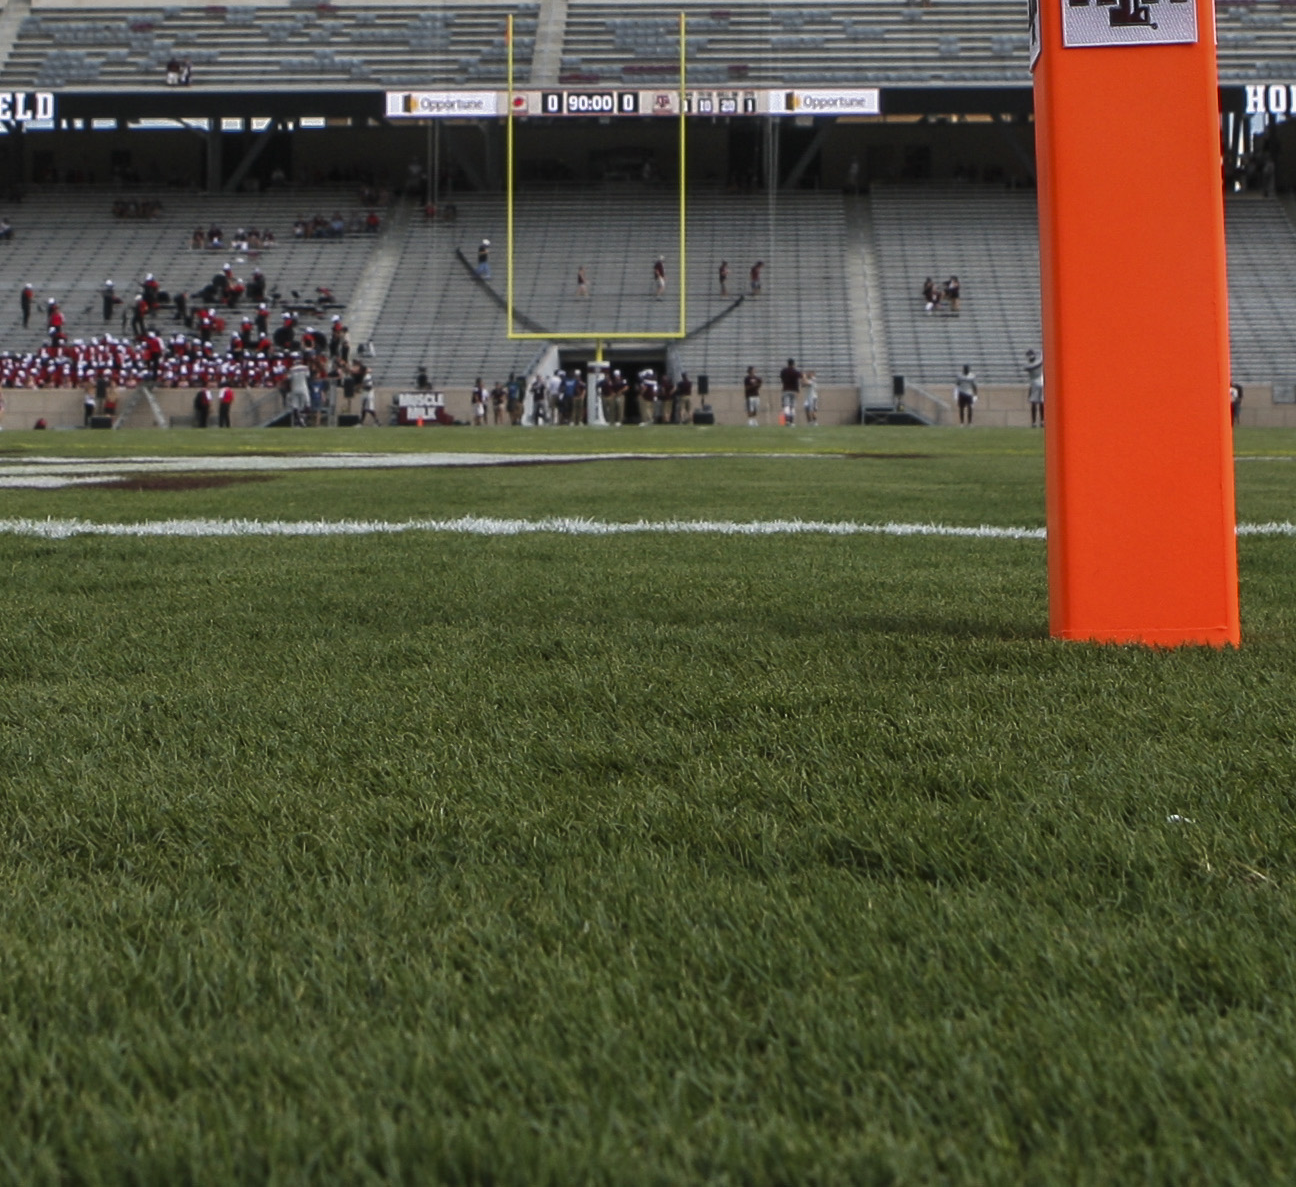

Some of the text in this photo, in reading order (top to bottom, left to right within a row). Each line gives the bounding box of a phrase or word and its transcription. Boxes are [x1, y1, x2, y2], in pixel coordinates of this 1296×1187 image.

[420, 97, 484, 112] Opportune
[548, 95, 558, 112] 0
[568, 95, 612, 111] 90:00
[623, 95, 634, 112] 0
[804, 95, 866, 111] Opportune
